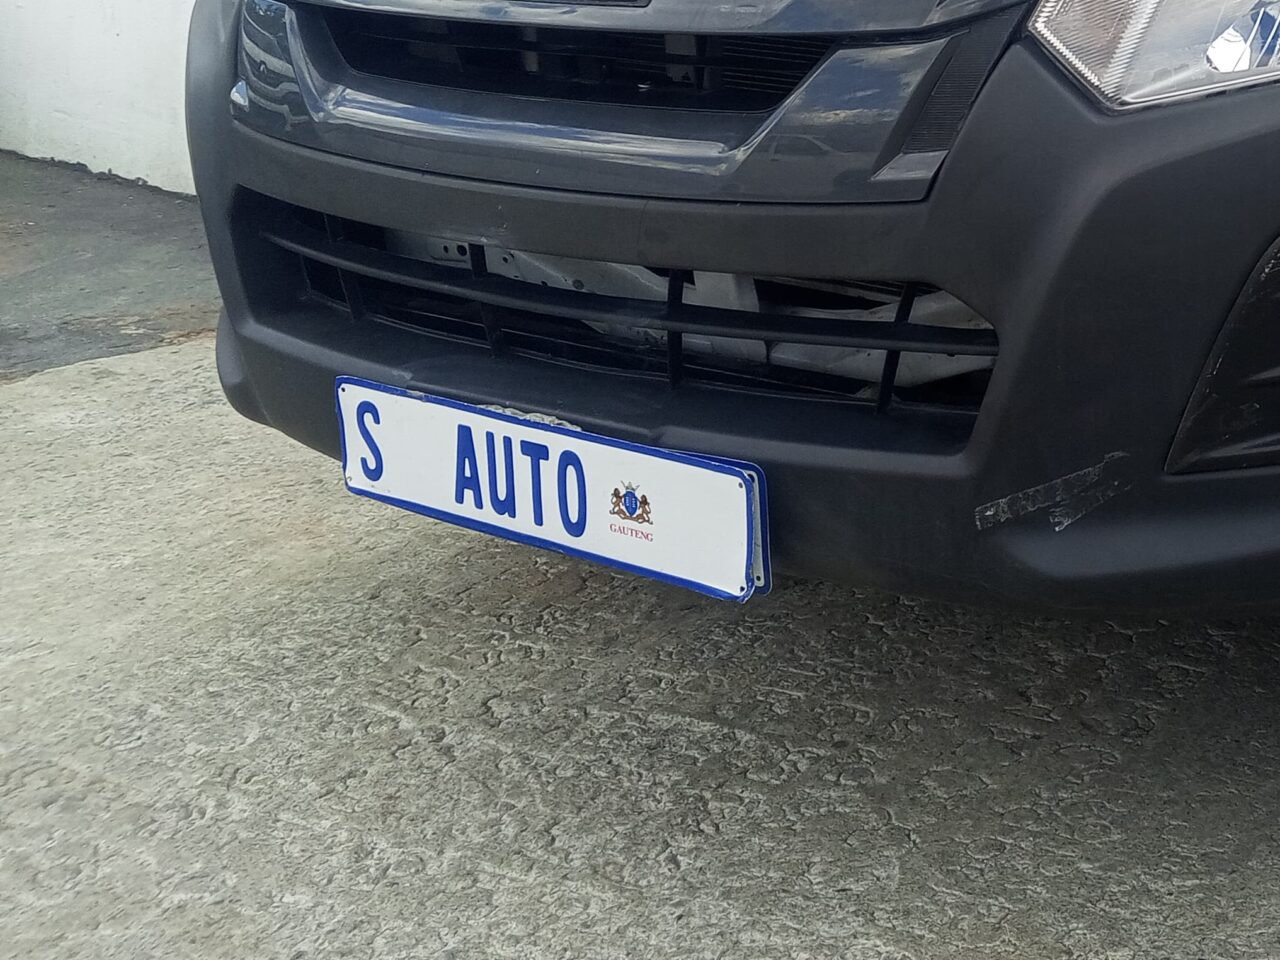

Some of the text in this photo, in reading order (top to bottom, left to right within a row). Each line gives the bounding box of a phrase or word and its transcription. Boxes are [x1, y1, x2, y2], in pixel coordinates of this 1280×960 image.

[355, 400, 587, 538] S AUTO
[609, 523, 653, 542] GAUTENG
